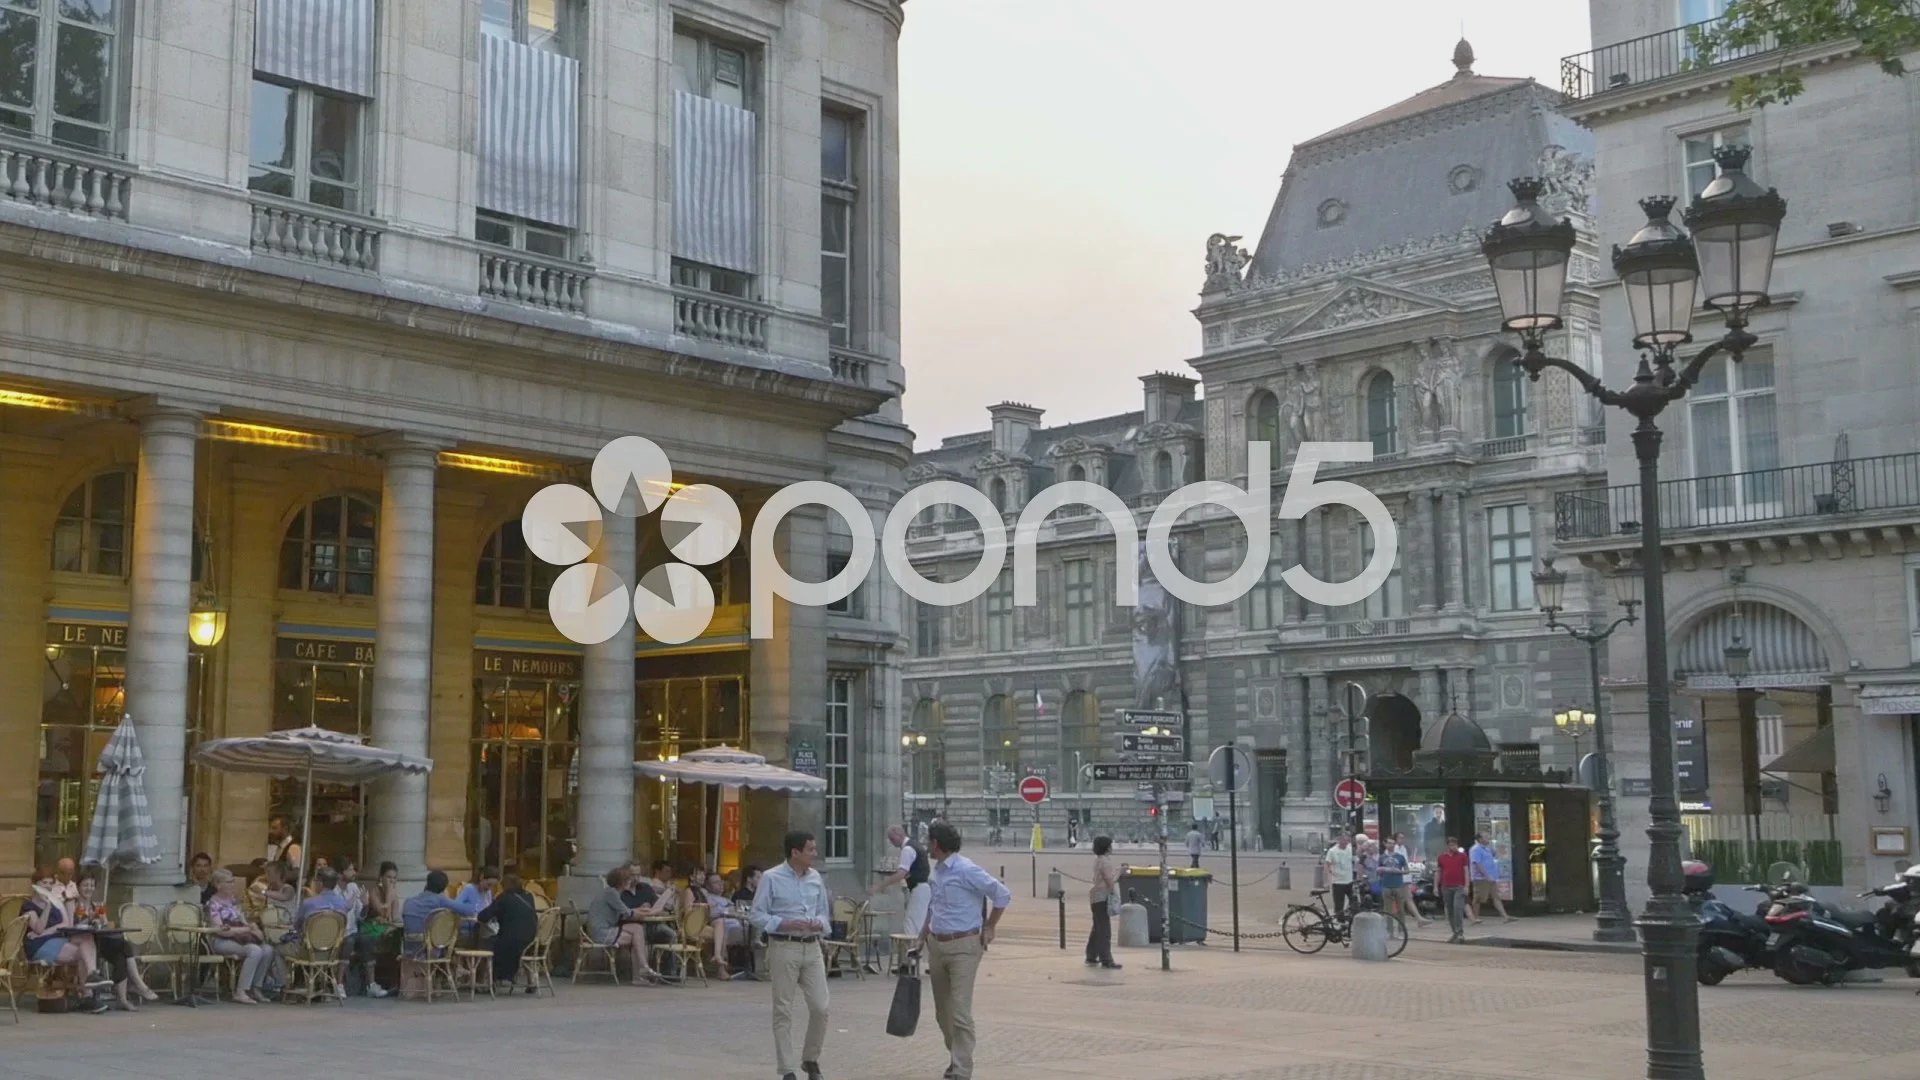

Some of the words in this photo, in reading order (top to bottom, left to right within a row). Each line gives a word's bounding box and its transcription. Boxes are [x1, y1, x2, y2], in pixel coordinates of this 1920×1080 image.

[64, 625, 87, 642] LE
[484, 656, 502, 671] LE
[512, 658, 575, 675] NEMOURS
